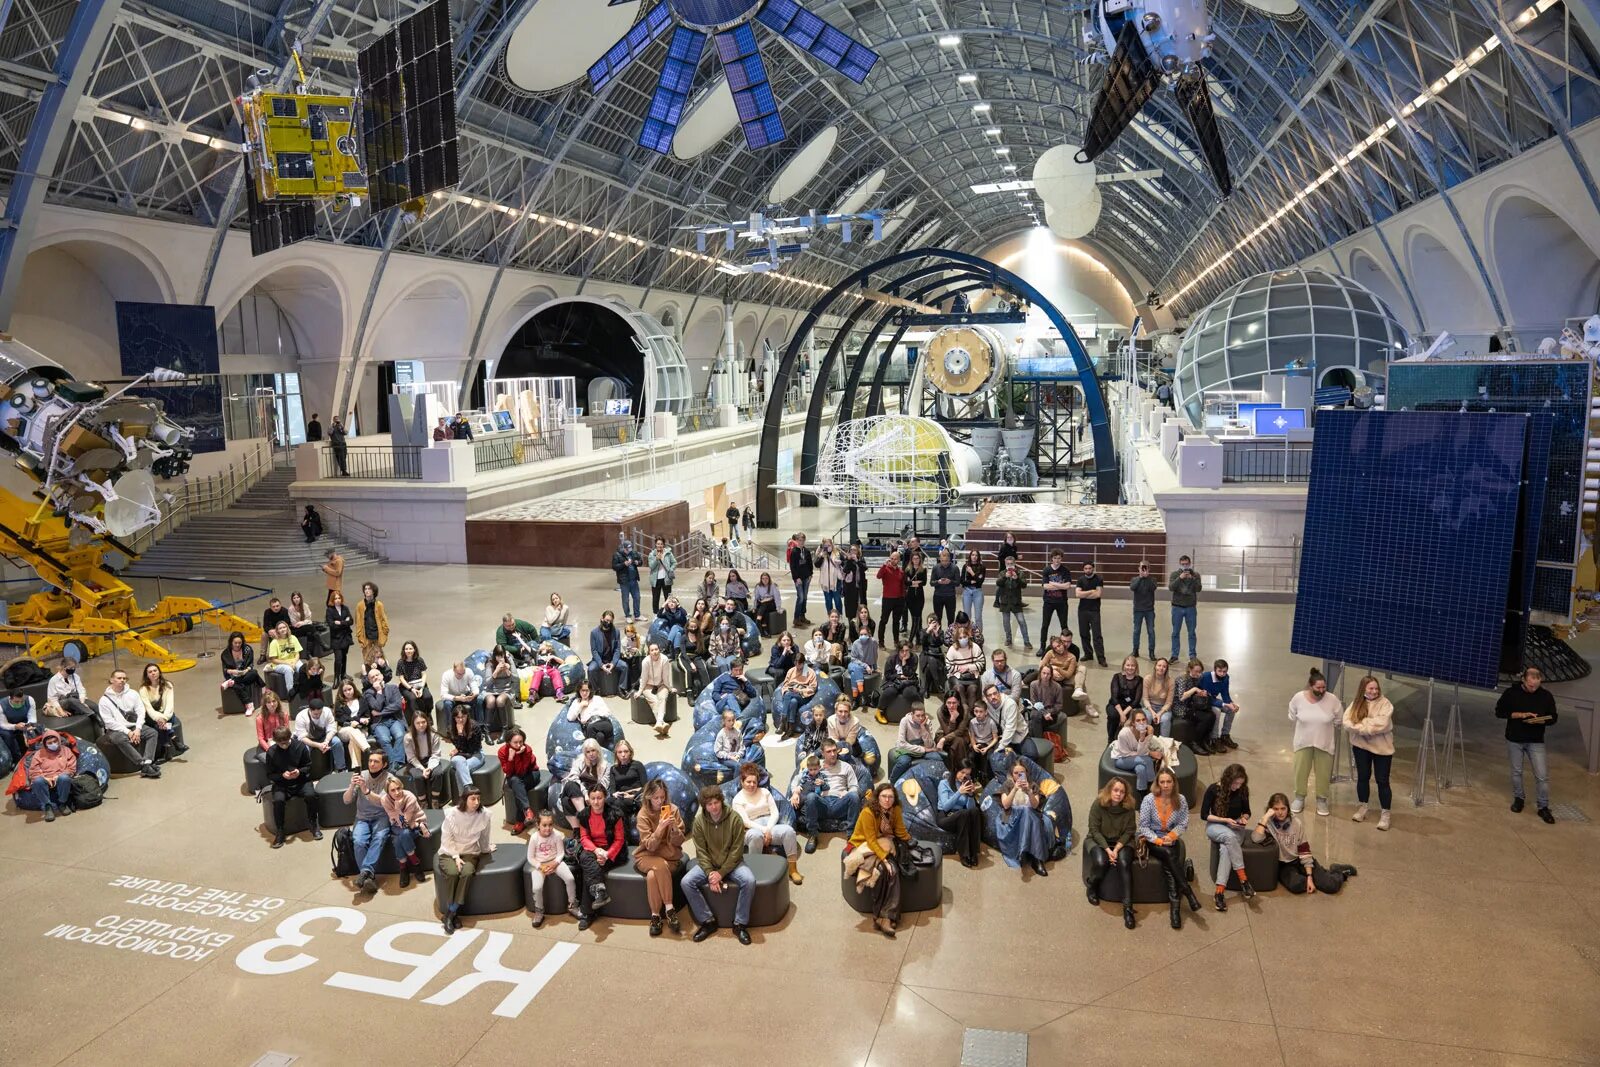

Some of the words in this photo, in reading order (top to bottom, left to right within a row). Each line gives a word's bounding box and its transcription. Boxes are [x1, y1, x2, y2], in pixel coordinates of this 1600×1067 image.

[108, 875, 202, 897] FUTURE
[196, 887, 248, 905] THE
[126, 893, 269, 923] SPACEPORT
[245, 896, 286, 910] OF
[43, 923, 214, 962] КОСМОДРОМ
[95, 915, 236, 948] БУДУЩЕГО
